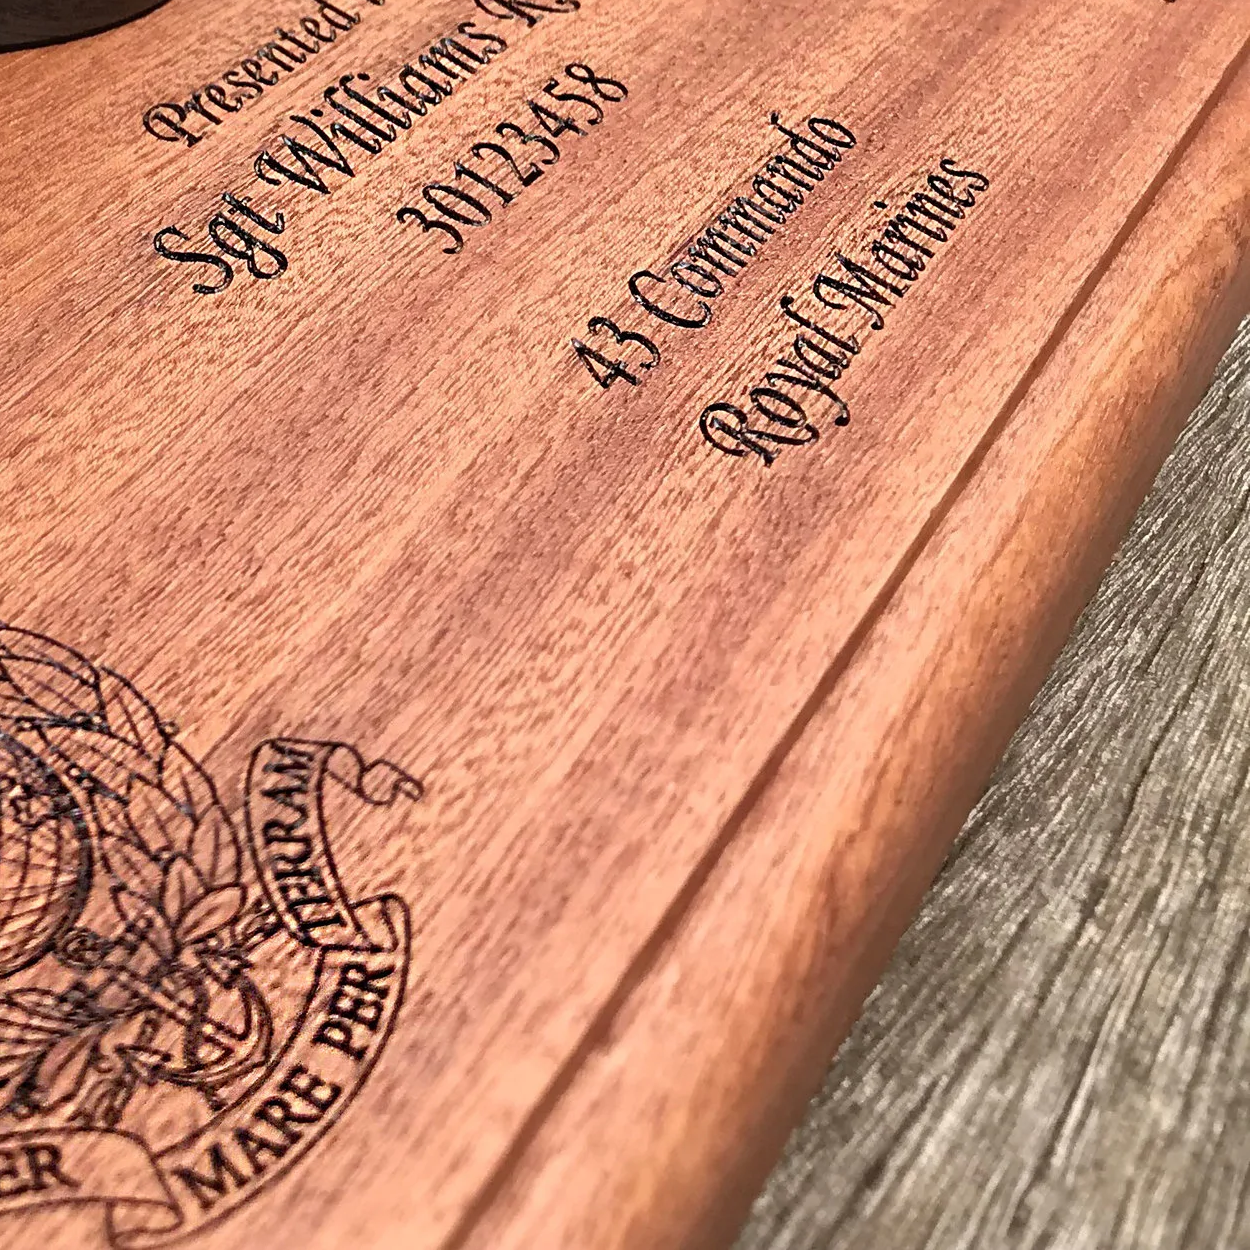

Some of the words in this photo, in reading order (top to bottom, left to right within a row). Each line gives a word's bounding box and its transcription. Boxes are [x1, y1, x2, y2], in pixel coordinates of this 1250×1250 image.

[153, 192, 289, 295] Sgt
[254, 21, 508, 196] Williams
[396, 61, 629, 255] 30123458
[571, 315, 661, 390] 43
[628, 111, 857, 330] Commando
[699, 295, 862, 467] Royal
[813, 158, 990, 331] Marines
[260, 745, 349, 932] TERRAM
[312, 958, 397, 1062] PER
[170, 1063, 343, 1209] MARE
